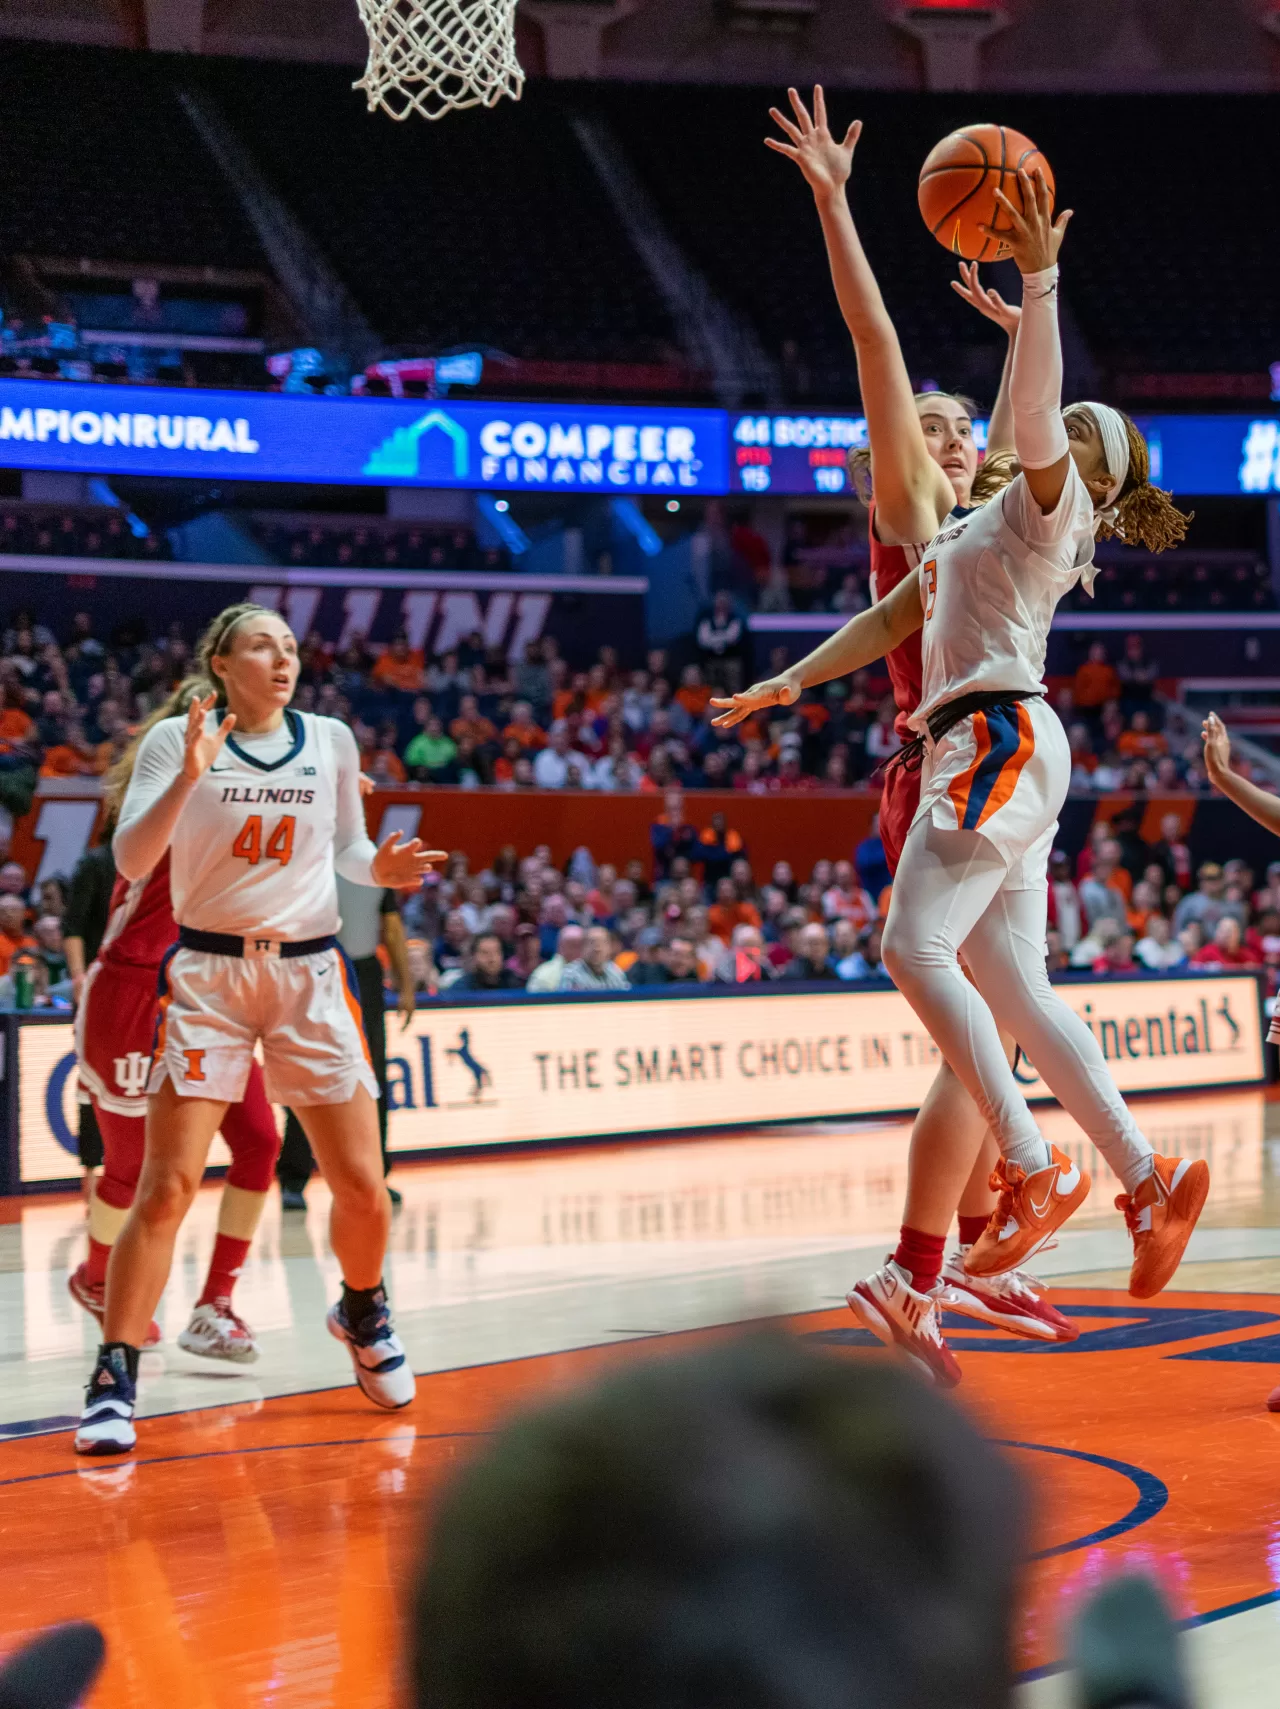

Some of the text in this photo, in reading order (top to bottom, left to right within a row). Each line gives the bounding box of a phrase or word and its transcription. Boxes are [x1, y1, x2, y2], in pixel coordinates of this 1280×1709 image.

[480, 420, 695, 462] COMPEER
[481, 455, 698, 487] FINANCIAL
[221, 787, 315, 804] ILLINOIS
[232, 814, 297, 867] 44
[533, 1051, 602, 1091] THE
[614, 1042, 723, 1087] SMART
[737, 1033, 852, 1079] CHOICE
[861, 1035, 891, 1068] IN
